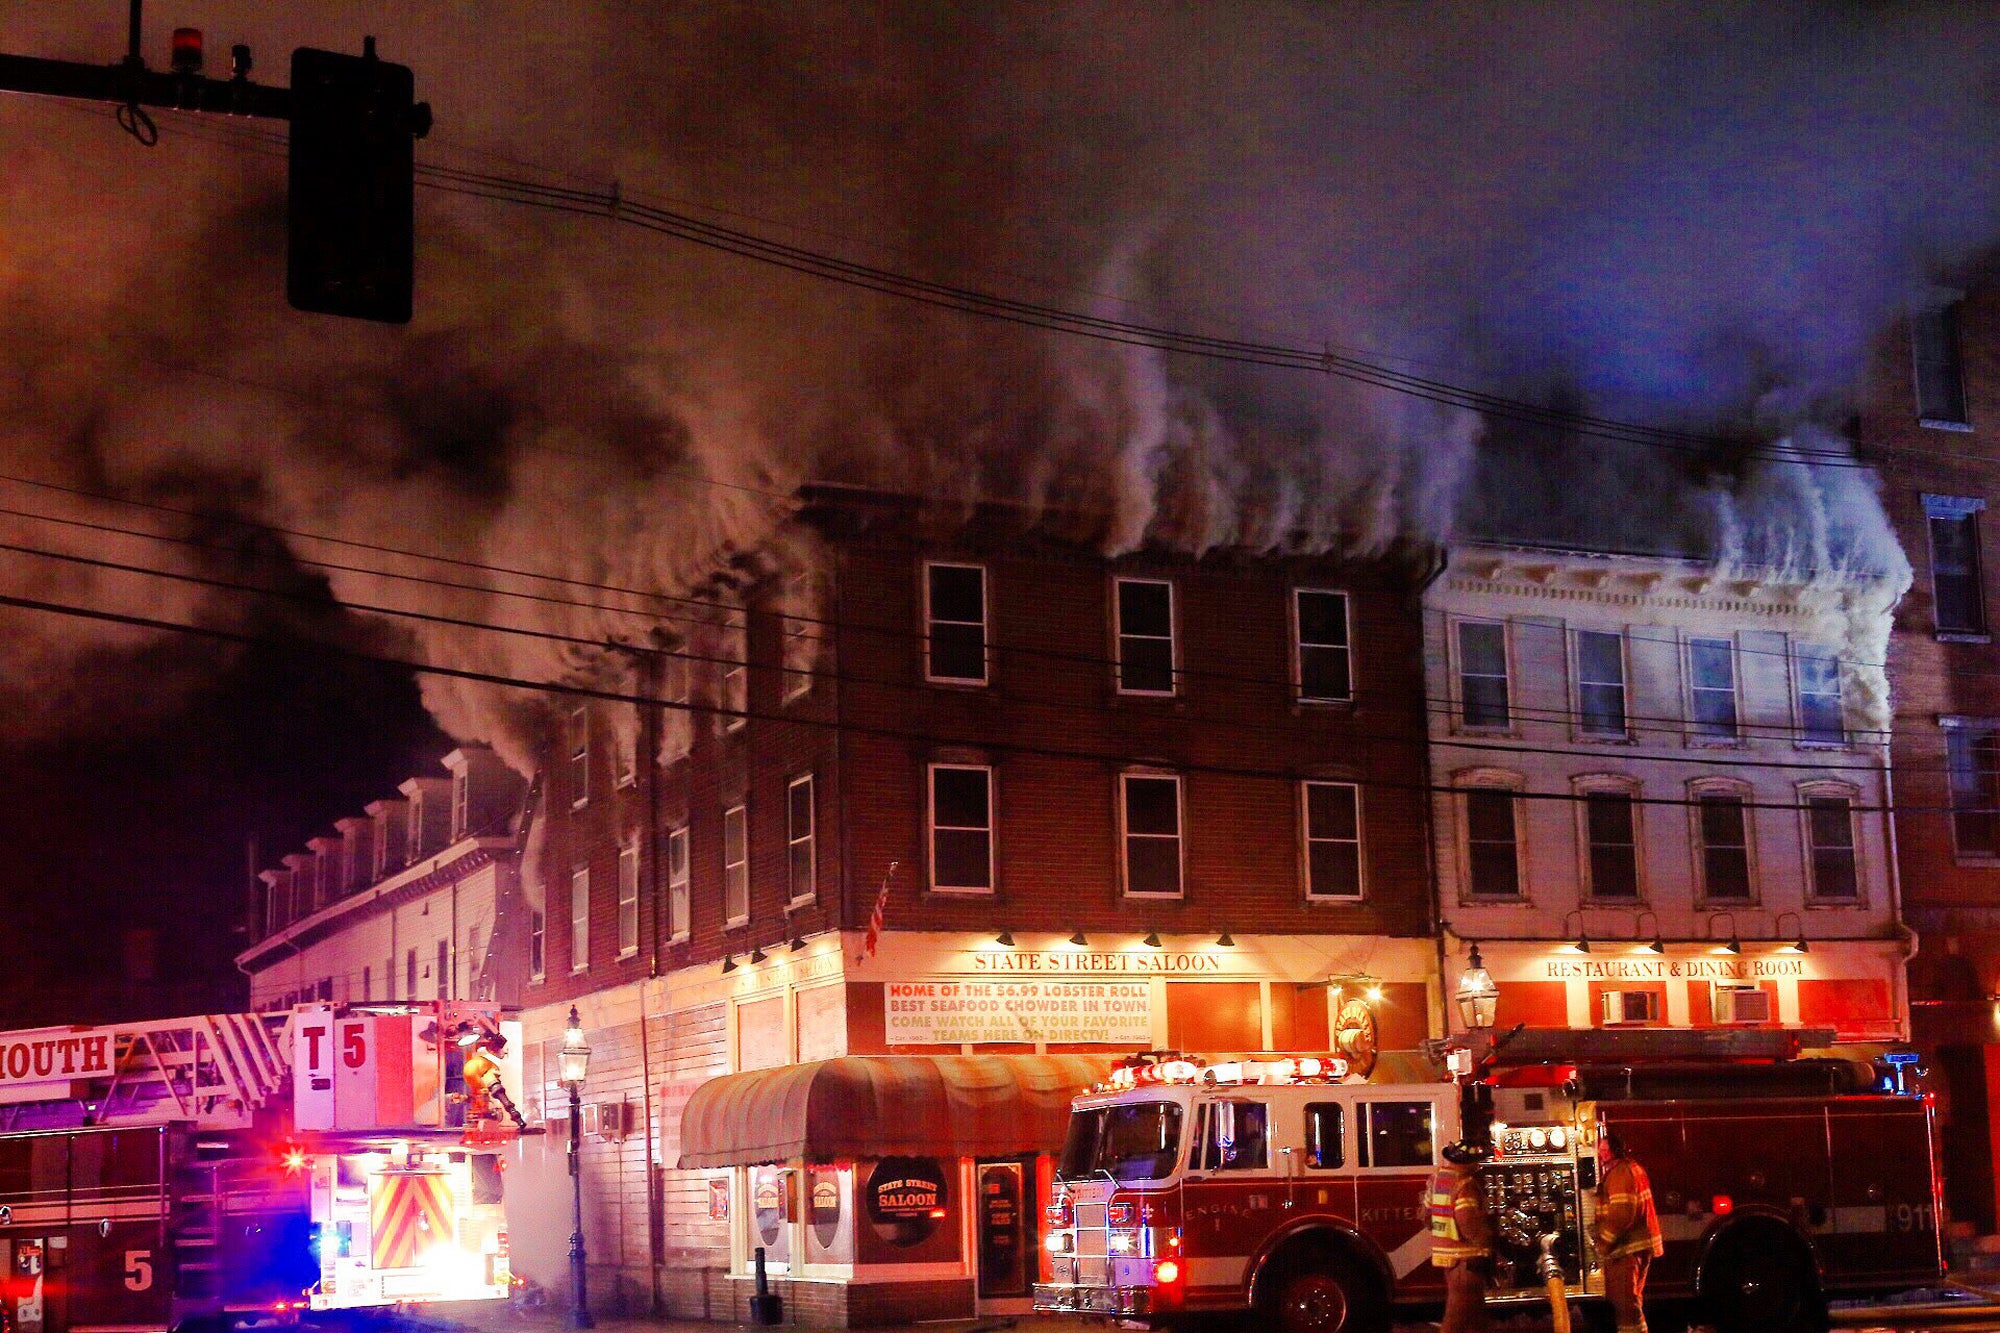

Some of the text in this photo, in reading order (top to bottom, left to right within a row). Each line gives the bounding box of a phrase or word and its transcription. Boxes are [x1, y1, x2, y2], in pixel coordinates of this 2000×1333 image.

[975, 953, 1220, 971] STATE STREET SALOON
[1547, 960, 1803, 977] RESTAURANT & DINING ROOM
[890, 985, 1146, 998] HOME OF THE $6.99 LOBSTER ROLL
[890, 1000, 925, 1012] BEST
[930, 1000, 999, 1012] SEAFOOD
[1005, 1000, 1078, 1012] CHOWDER
[1083, 1000, 1098, 1012] IN
[891, 1016, 1147, 1028] COME WATCH ALL OF YOUR FAVORITE
[933, 1029, 977, 1041] TEAMS
[984, 1029, 1018, 1041] HERE
[1024, 1029, 1043, 1041] ON
[1049, 1029, 1109, 1041] DIRECTV!
[303, 1023, 366, 1069] T 5
[0, 1036, 107, 1079] OUTH
[878, 1179, 938, 1193] STATE STREET
[879, 1193, 937, 1207] SALOON
[124, 1250, 152, 1291] 5
